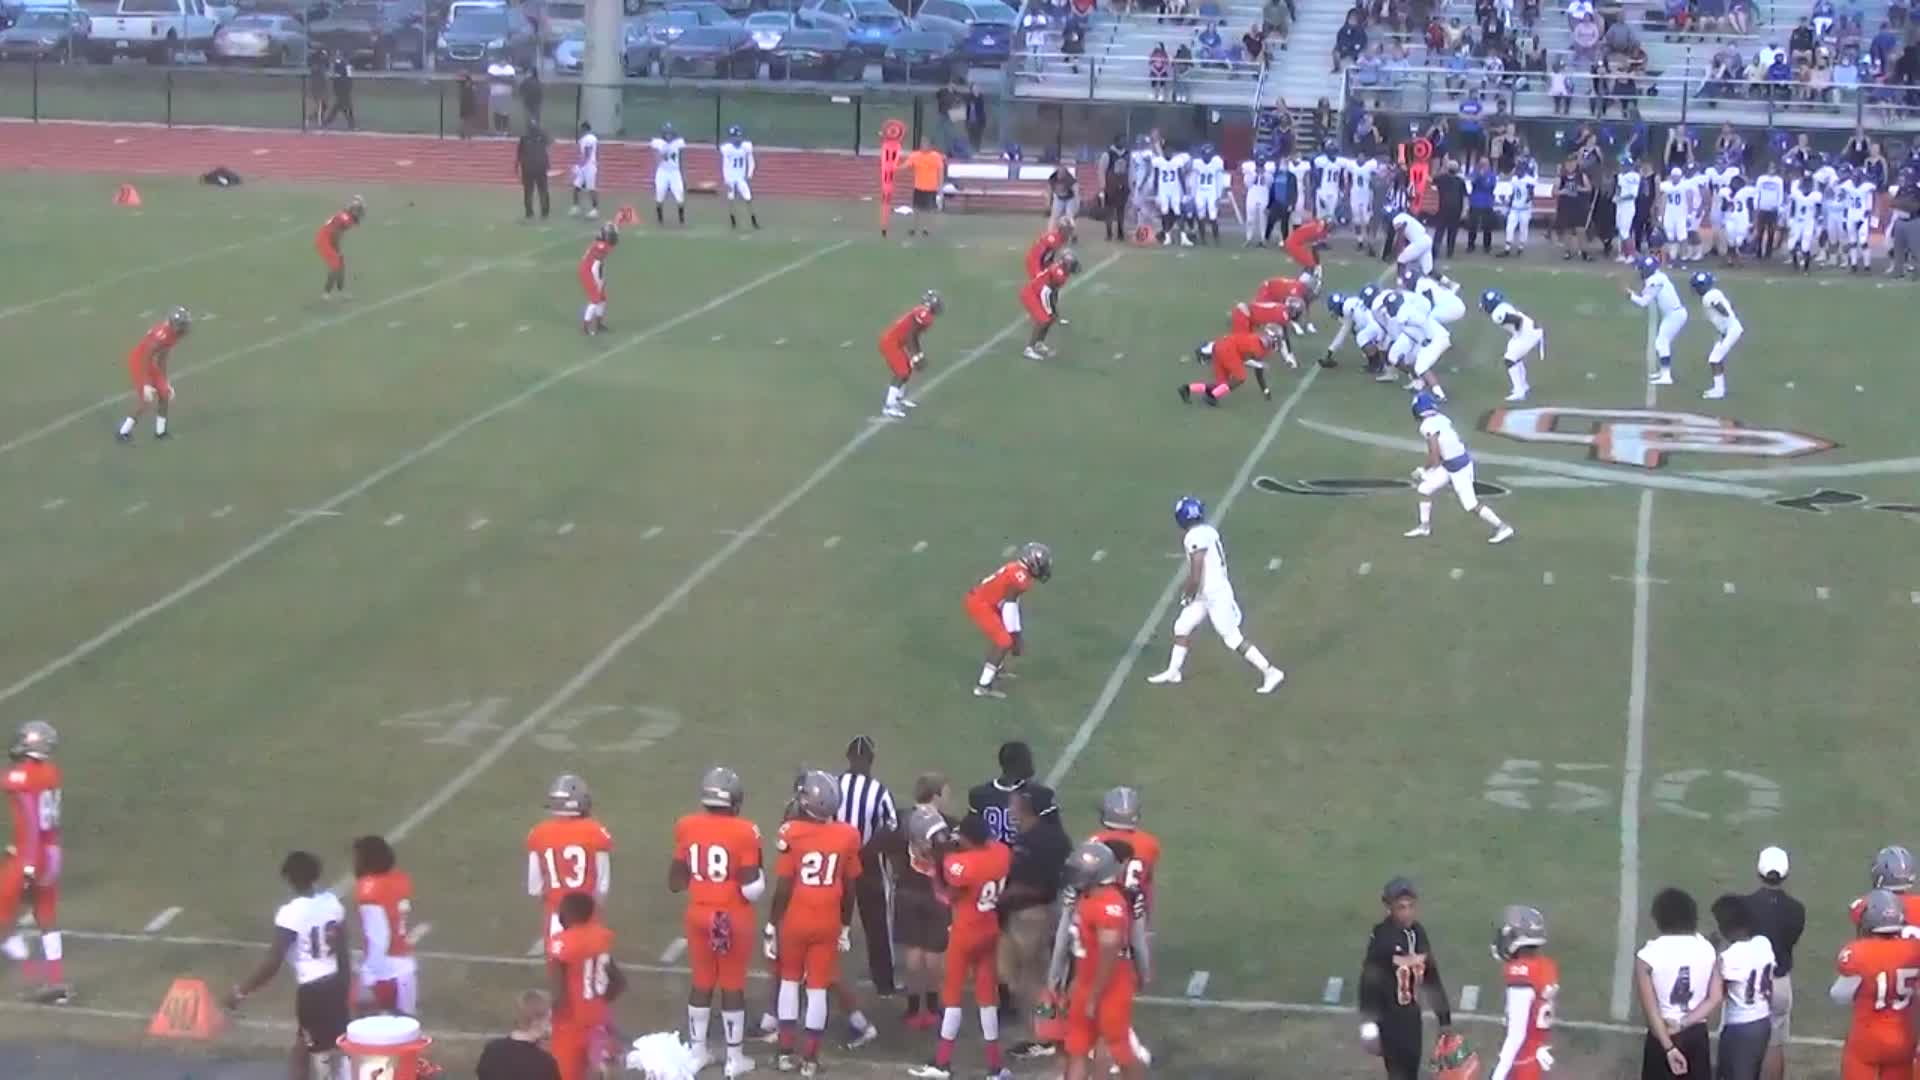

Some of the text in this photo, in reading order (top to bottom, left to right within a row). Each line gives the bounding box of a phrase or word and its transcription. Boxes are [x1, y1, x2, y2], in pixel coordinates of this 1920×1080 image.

[380, 697, 682, 752] 40
[1483, 758, 1785, 823] 50
[544, 845, 585, 889] 13
[688, 843, 728, 883] 18
[801, 852, 839, 886] 21
[1670, 966, 1693, 1013] 4
[1875, 968, 1918, 1010] 15
